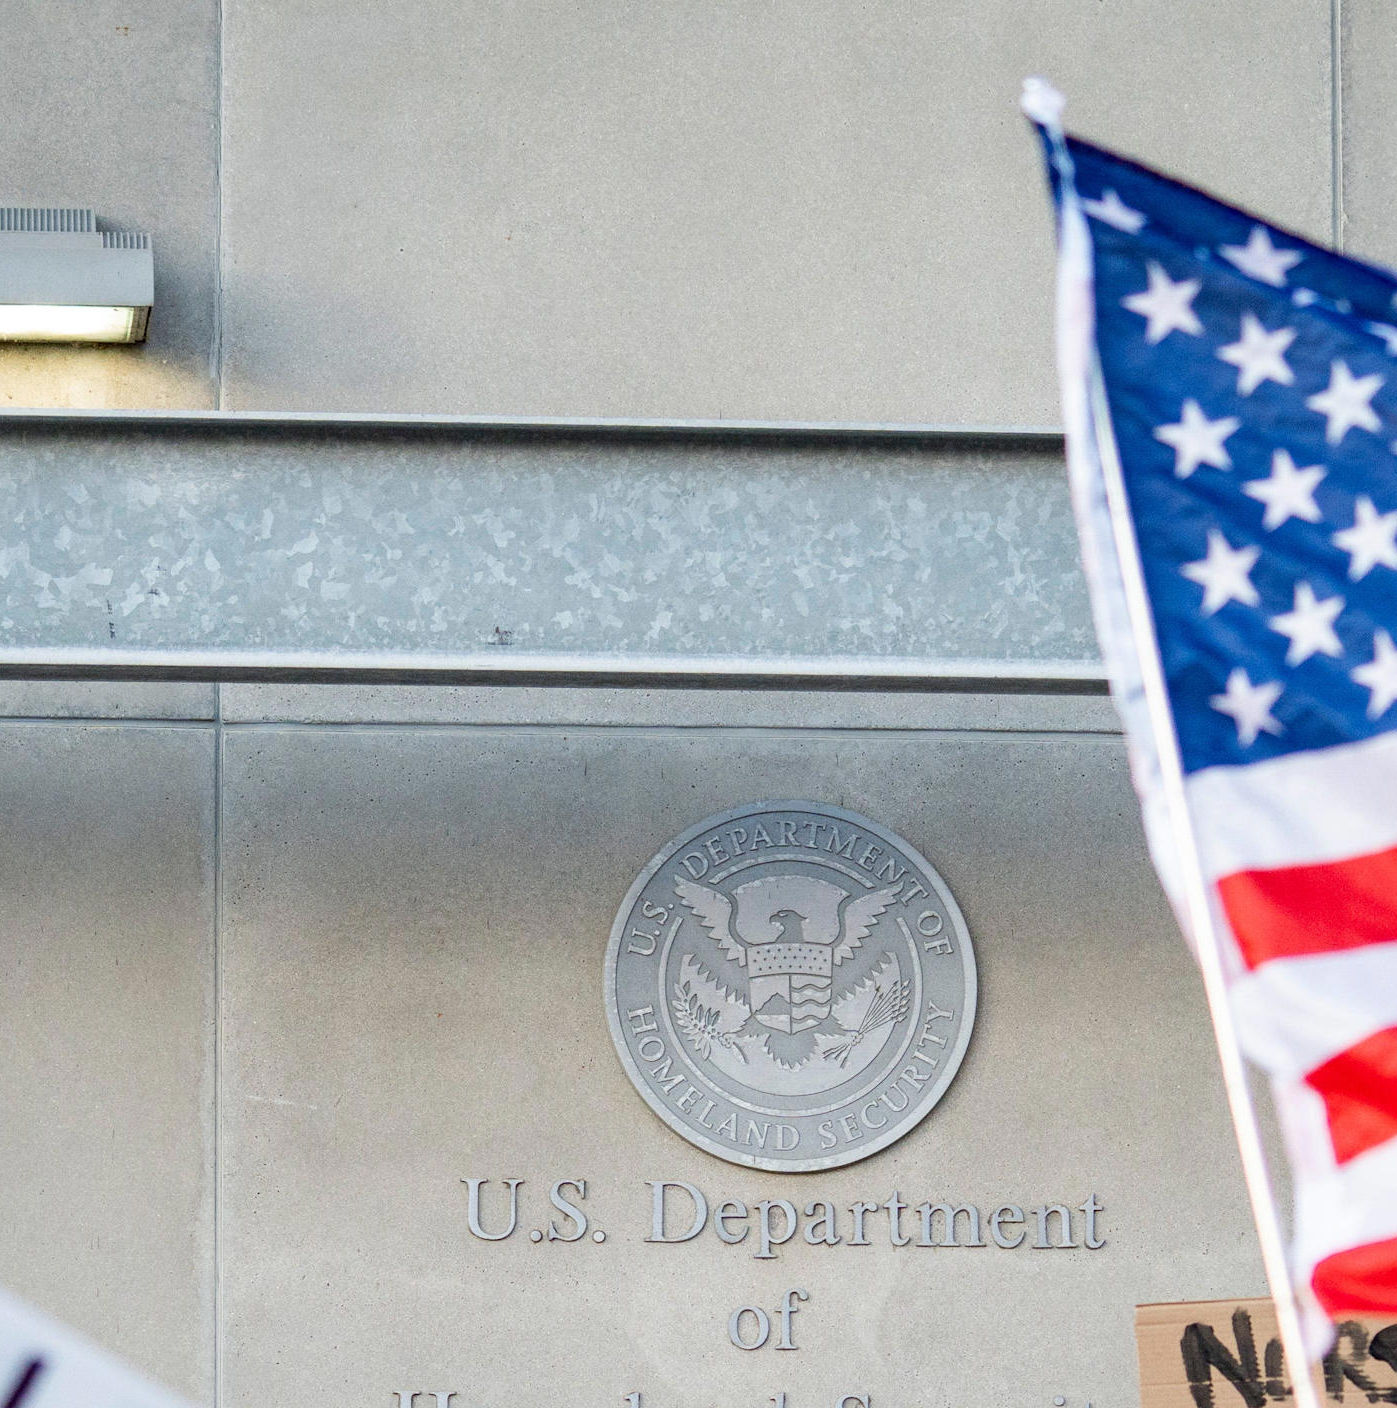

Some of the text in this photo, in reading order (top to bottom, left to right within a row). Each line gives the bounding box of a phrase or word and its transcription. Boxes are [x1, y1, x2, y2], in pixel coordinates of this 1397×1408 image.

[627, 820, 954, 957] U.S. DEPARTMENT OF
[627, 1000, 955, 1152] HOMELAND SECURITY
[460, 1177, 1107, 1260] U.S. Department
[727, 1288, 809, 1351] of
